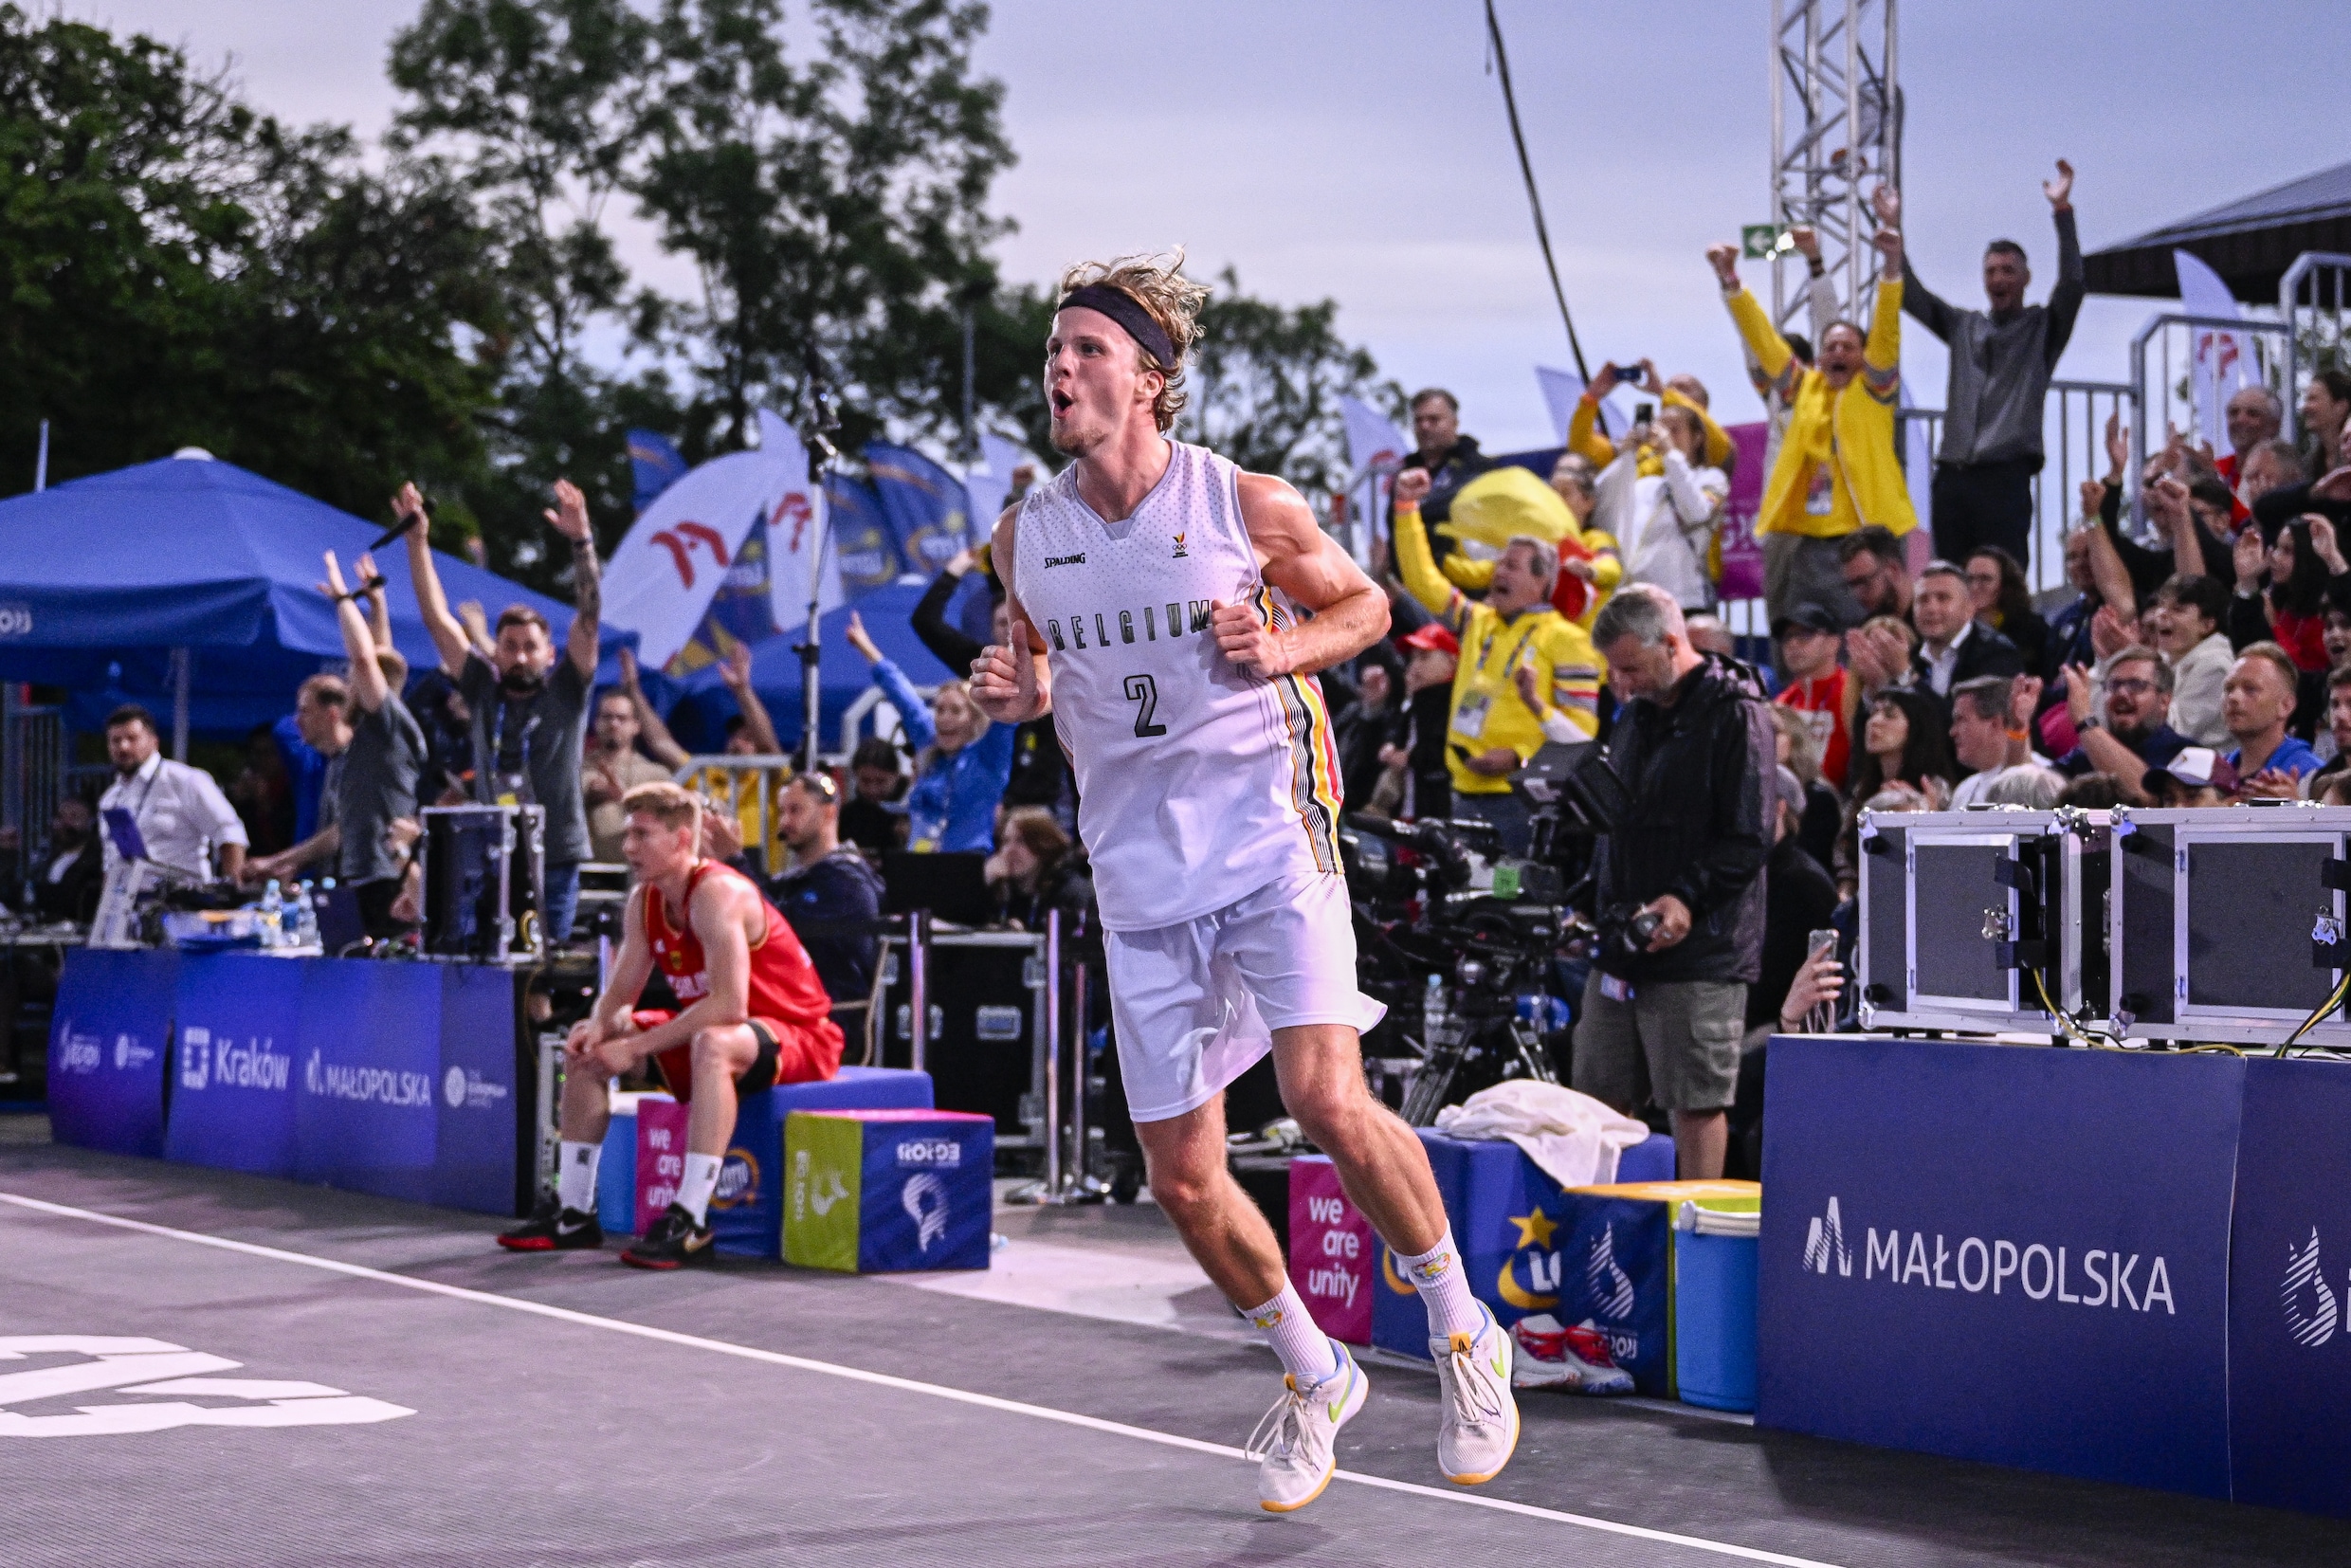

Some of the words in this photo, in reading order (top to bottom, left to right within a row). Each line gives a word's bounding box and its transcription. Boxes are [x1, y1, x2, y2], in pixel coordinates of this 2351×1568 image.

[1045, 553, 1085, 569] SPALDING
[1048, 599, 1210, 651] BELGIUM
[1123, 674, 1167, 738] 2
[215, 1037, 290, 1090] Kraków
[326, 1064, 431, 1107] MAŁOPOLSKA
[648, 1128, 671, 1150] we
[1309, 1196, 1343, 1224] we
[1323, 1230, 1359, 1258] are
[1309, 1262, 1359, 1308] unity
[1865, 1227, 2176, 1315] MAŁOPOLSKA
